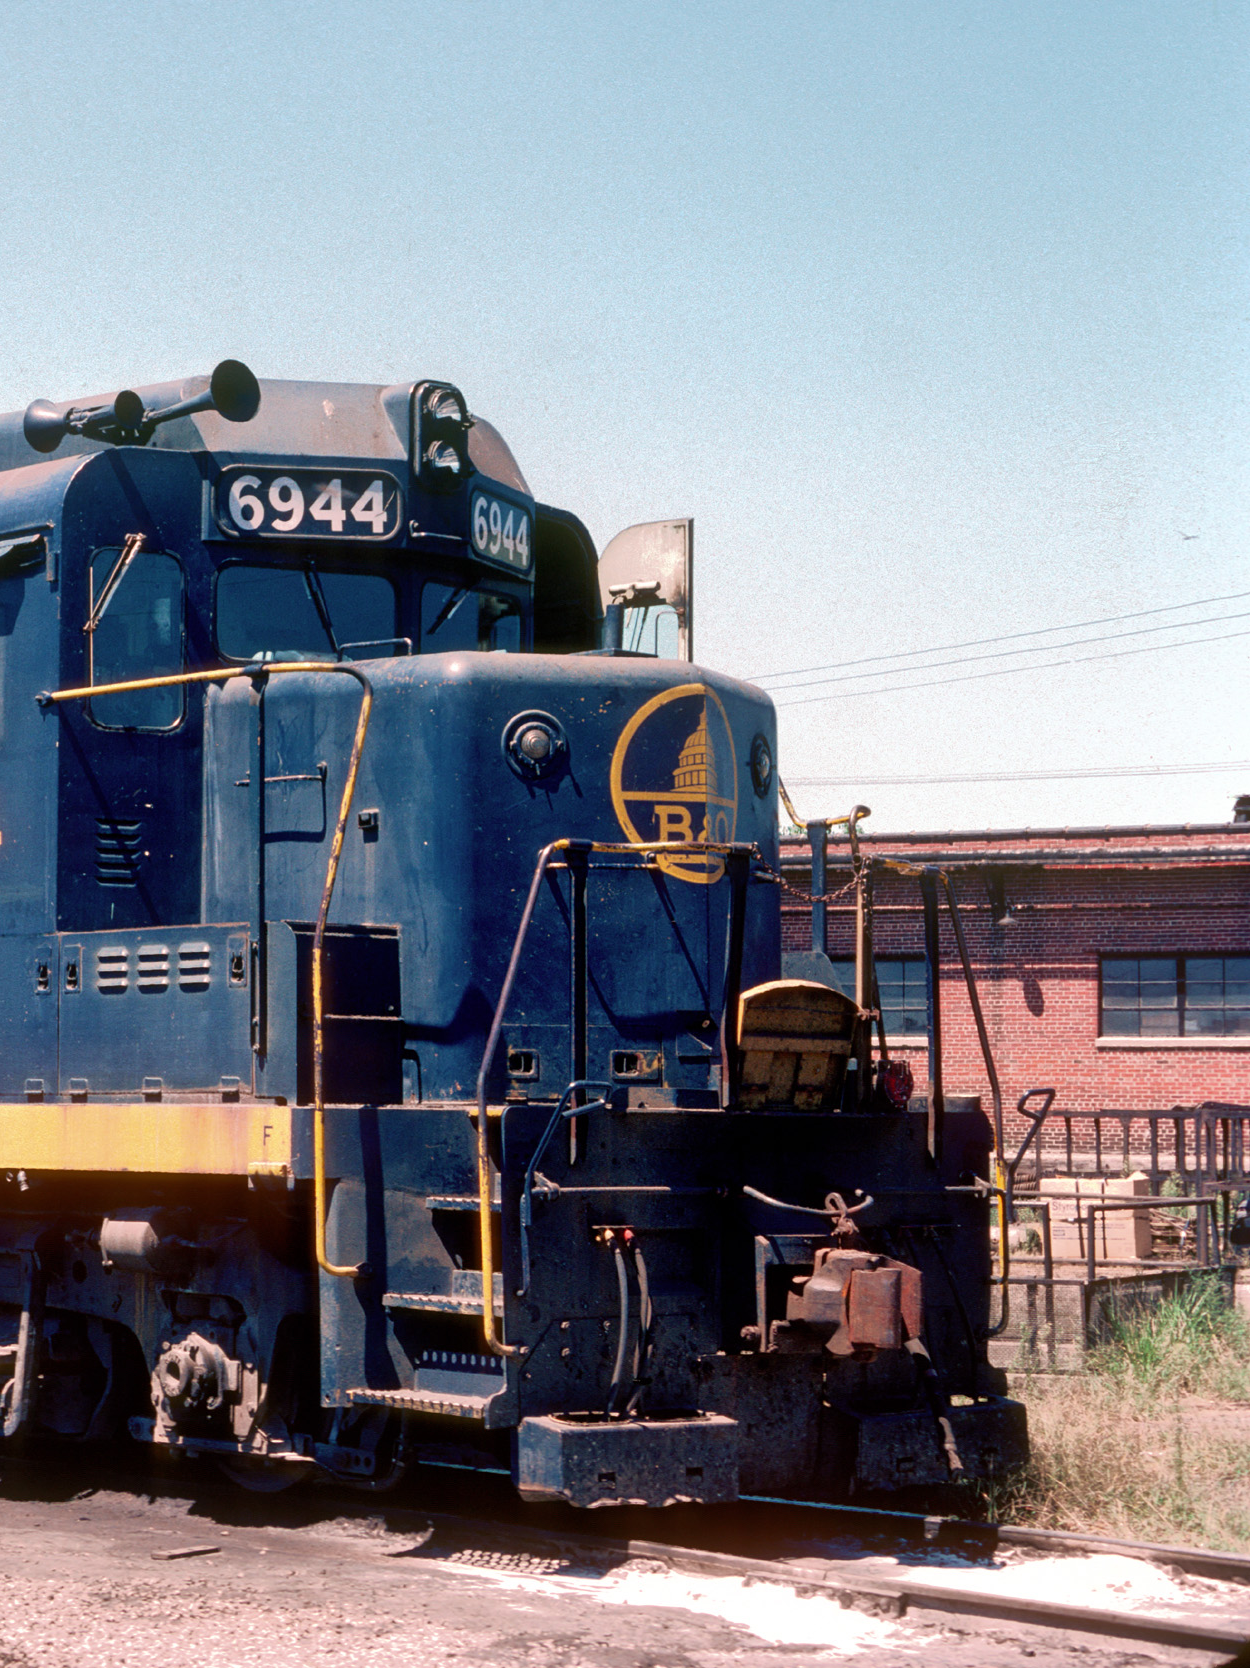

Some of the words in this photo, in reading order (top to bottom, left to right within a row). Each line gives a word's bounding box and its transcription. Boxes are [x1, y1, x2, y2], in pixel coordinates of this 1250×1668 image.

[229, 475, 388, 534] 6944
[473, 496, 529, 566] 6944
[263, 1125, 273, 1146] F
